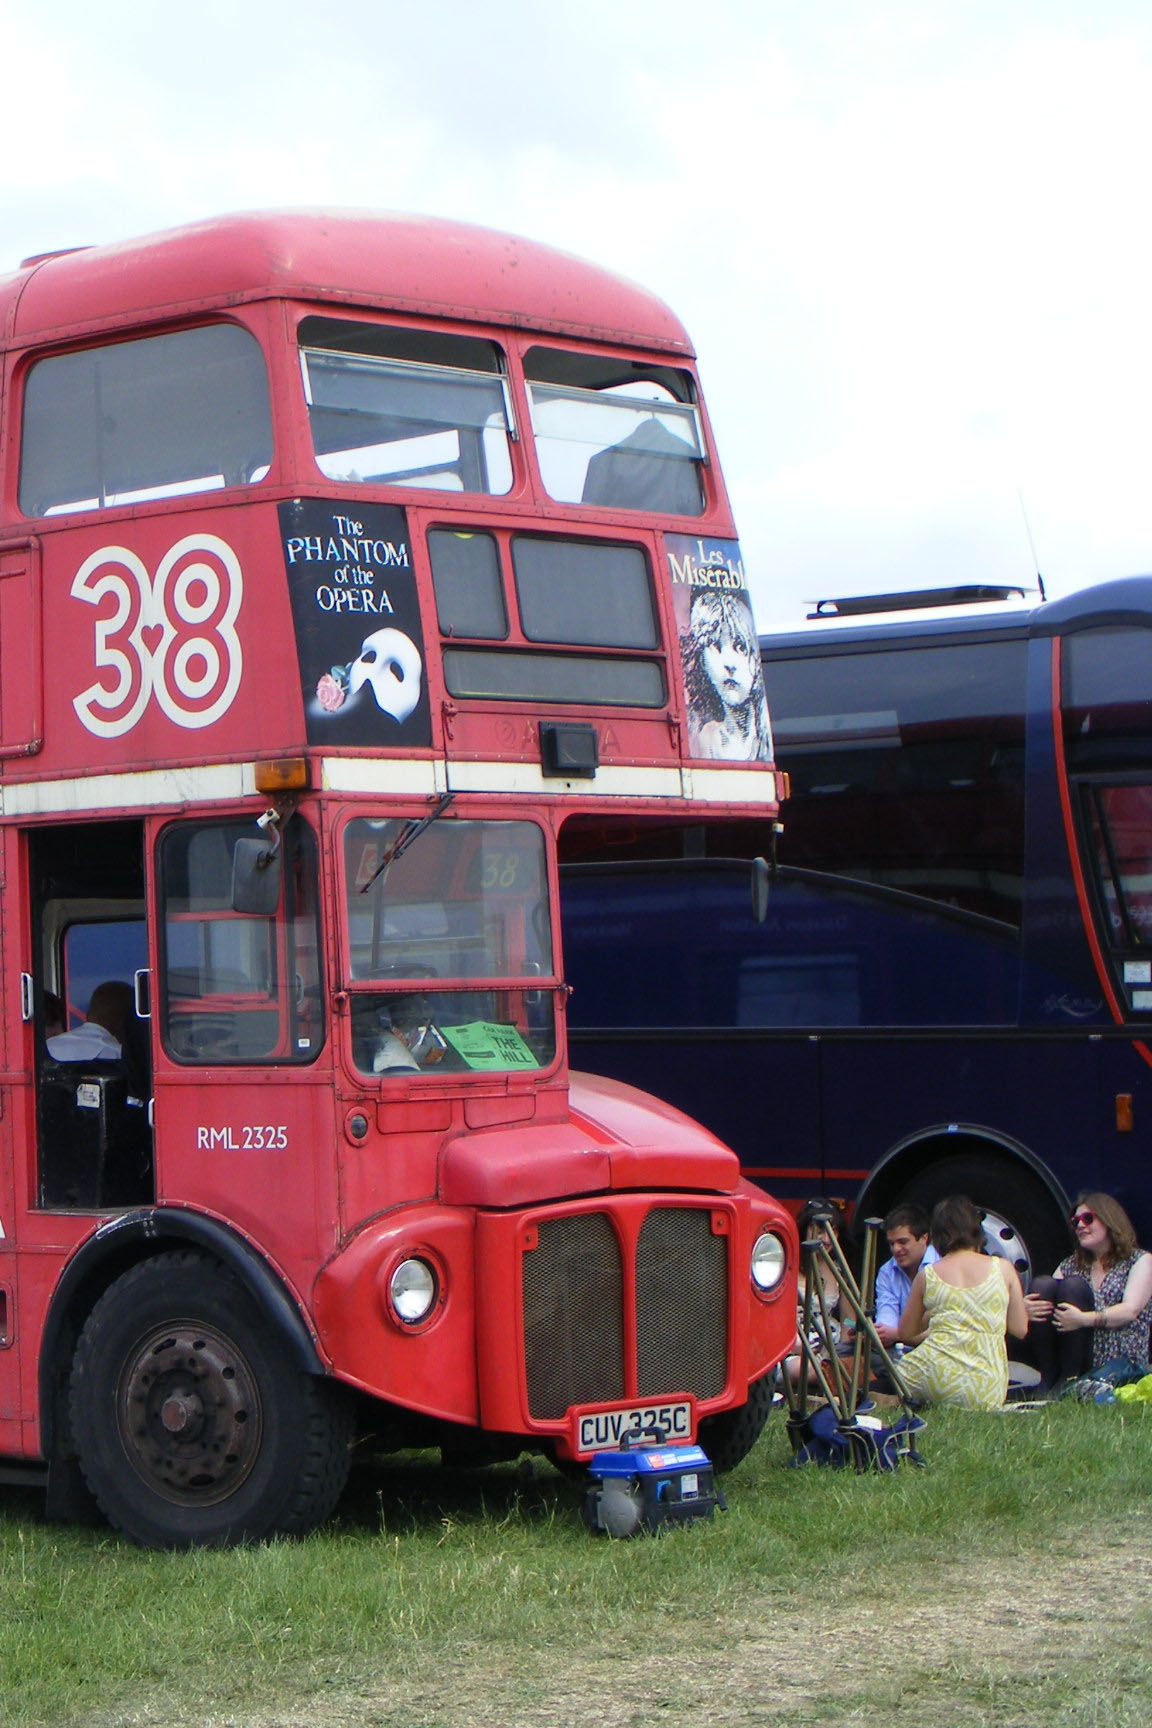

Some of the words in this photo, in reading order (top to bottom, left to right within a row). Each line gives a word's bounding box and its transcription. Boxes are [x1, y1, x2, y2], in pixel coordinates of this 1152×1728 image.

[333, 515, 364, 536] The
[288, 536, 409, 567] PHANTOM
[695, 540, 724, 565] Les
[334, 564, 350, 583] of
[352, 565, 375, 585] the
[316, 585, 394, 614] OPERA
[70, 533, 243, 739] 38
[491, 1036, 522, 1050] THE
[499, 1050, 533, 1064] HILL
[197, 1126, 240, 1150] RML
[242, 1125, 288, 1149] 2325
[581, 1414, 623, 1446] CUV
